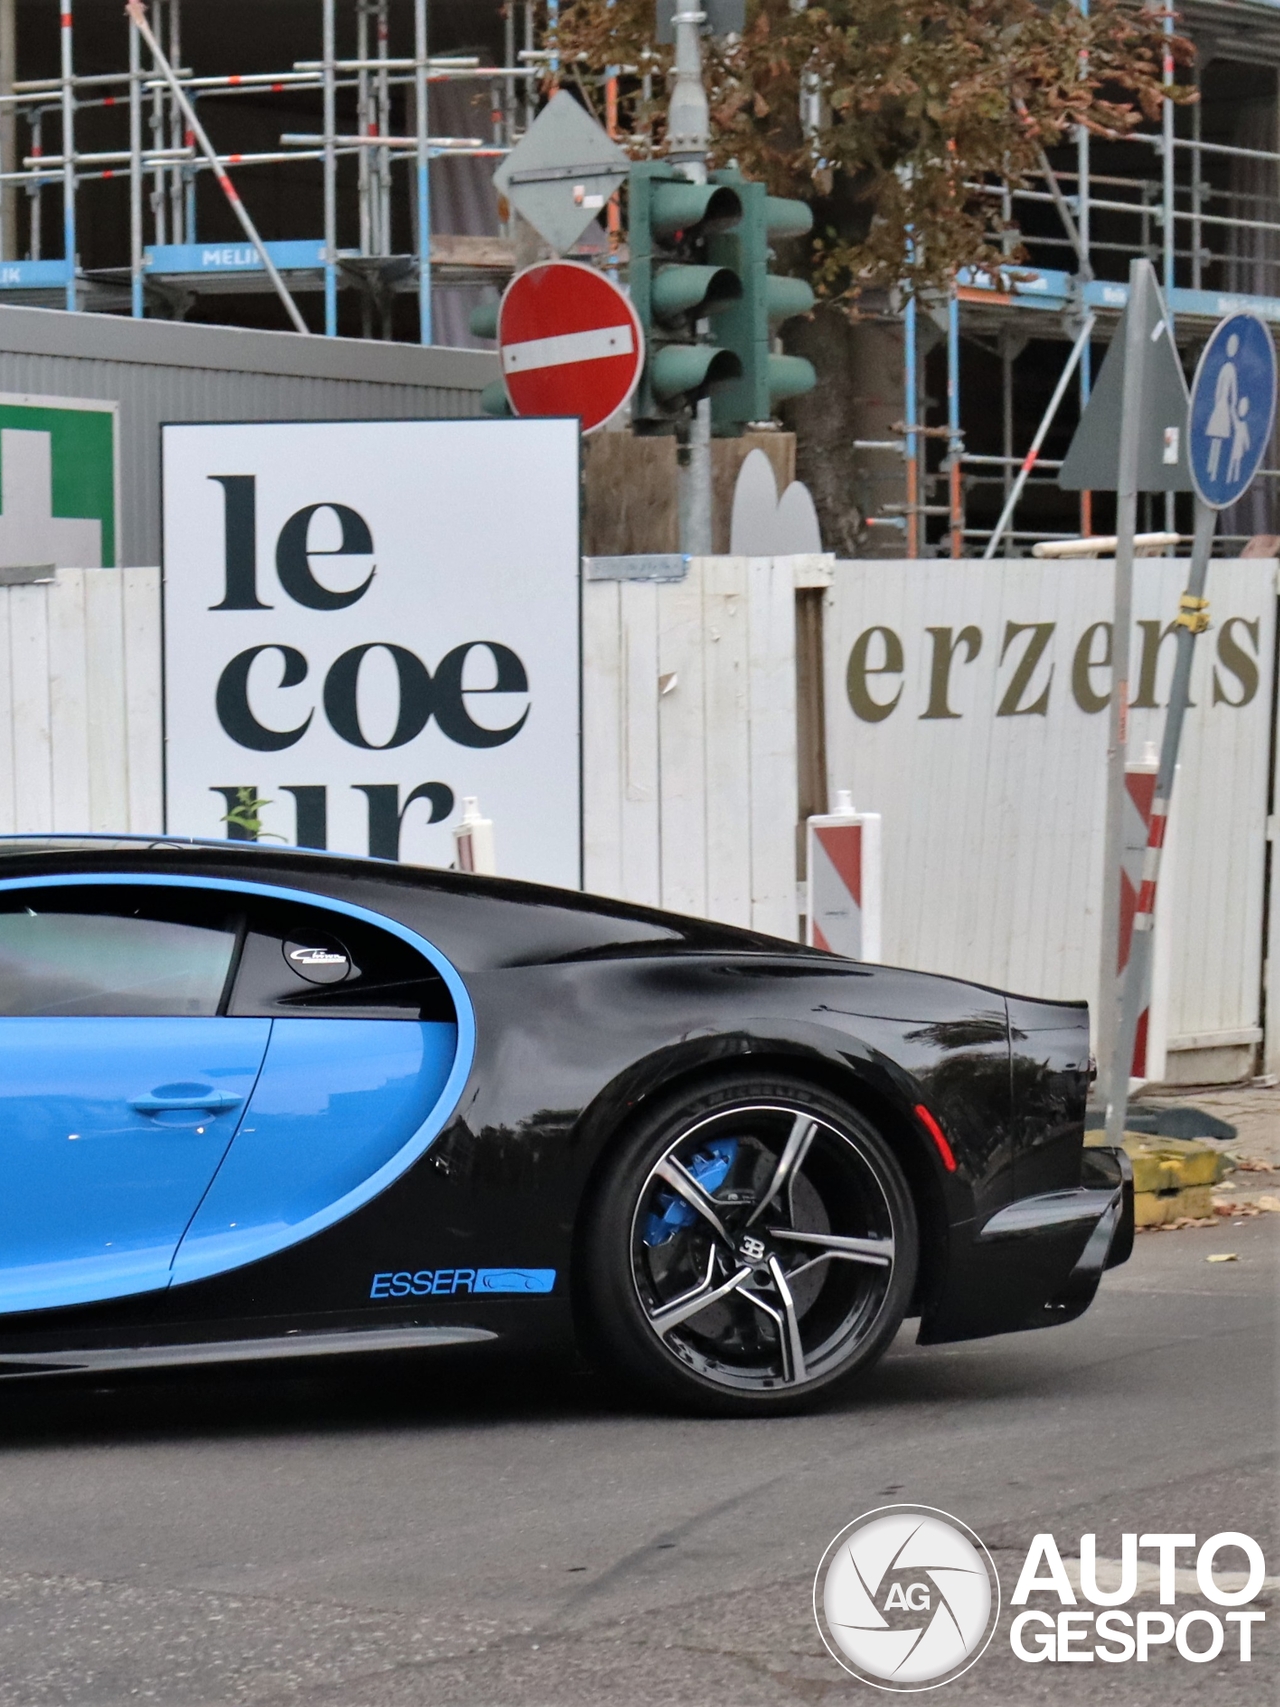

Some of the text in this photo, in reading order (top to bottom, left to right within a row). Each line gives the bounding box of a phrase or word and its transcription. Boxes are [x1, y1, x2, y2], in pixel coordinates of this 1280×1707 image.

[207, 474, 376, 611] le
[216, 640, 531, 752] coe
[846, 617, 1261, 724] erzens
[370, 1269, 475, 1298] ESSER
